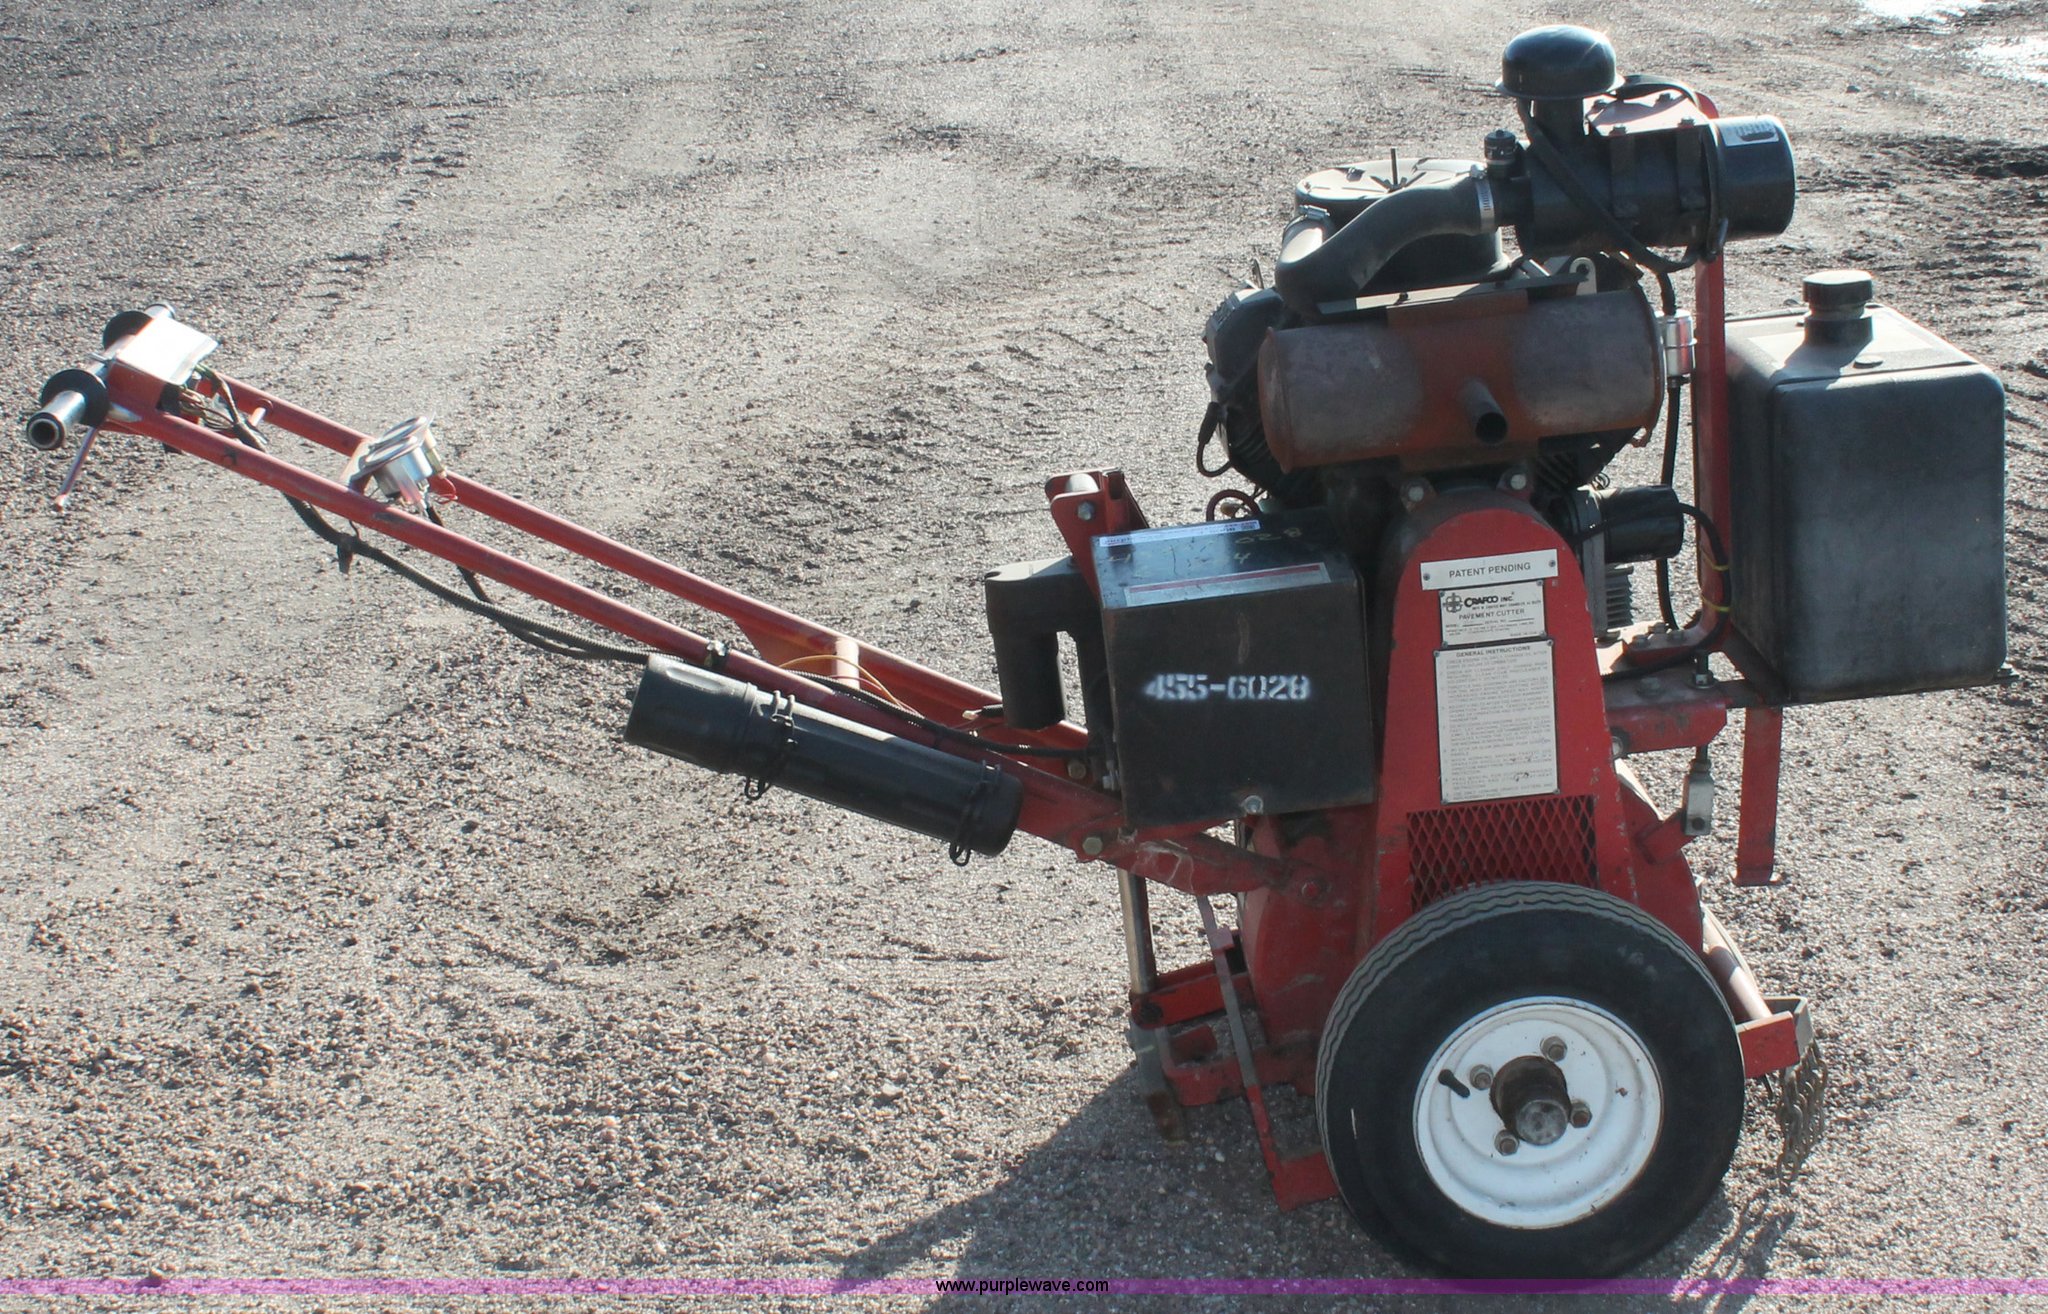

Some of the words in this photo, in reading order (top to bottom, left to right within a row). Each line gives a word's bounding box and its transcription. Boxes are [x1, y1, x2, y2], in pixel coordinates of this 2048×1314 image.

[1449, 567, 1486, 578] PATENT
[1488, 562, 1531, 573] PENDING
[1464, 595, 1499, 606] CRAFCO
[1459, 609, 1494, 620] PAVEMENT
[1496, 608, 1525, 617] CUTTER
[1456, 648, 1484, 658] GENERAL
[1486, 645, 1531, 655] INSTRUCTIONS
[1143, 673, 1312, 701] 455-6028
